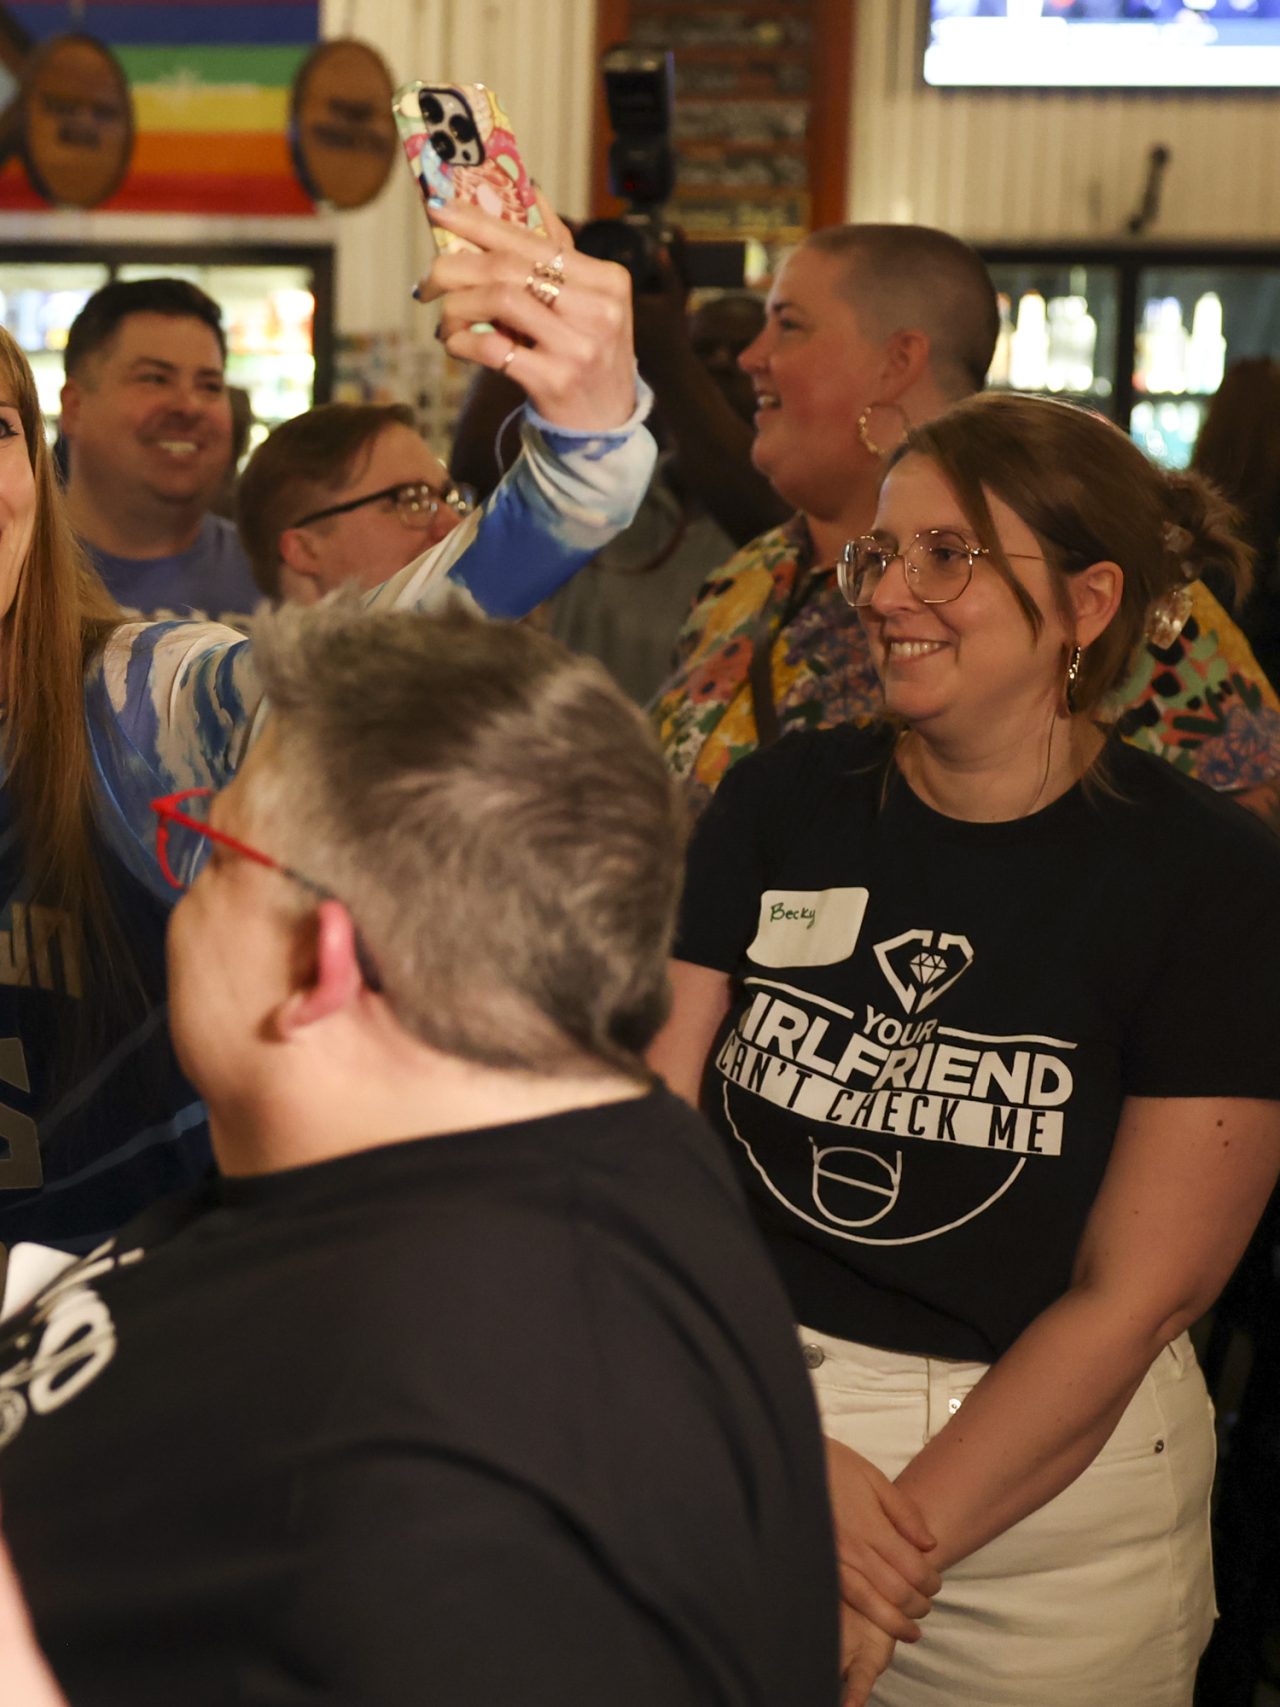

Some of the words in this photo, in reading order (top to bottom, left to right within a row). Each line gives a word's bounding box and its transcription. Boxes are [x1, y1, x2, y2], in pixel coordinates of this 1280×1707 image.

[770, 902, 816, 930] Becky
[739, 992, 1074, 1107] IRLFRIEND
[866, 1005, 938, 1048] YOUR
[719, 1034, 813, 1109] CAN'T
[825, 1089, 960, 1141] CHECK
[987, 1108, 1047, 1153] ME
